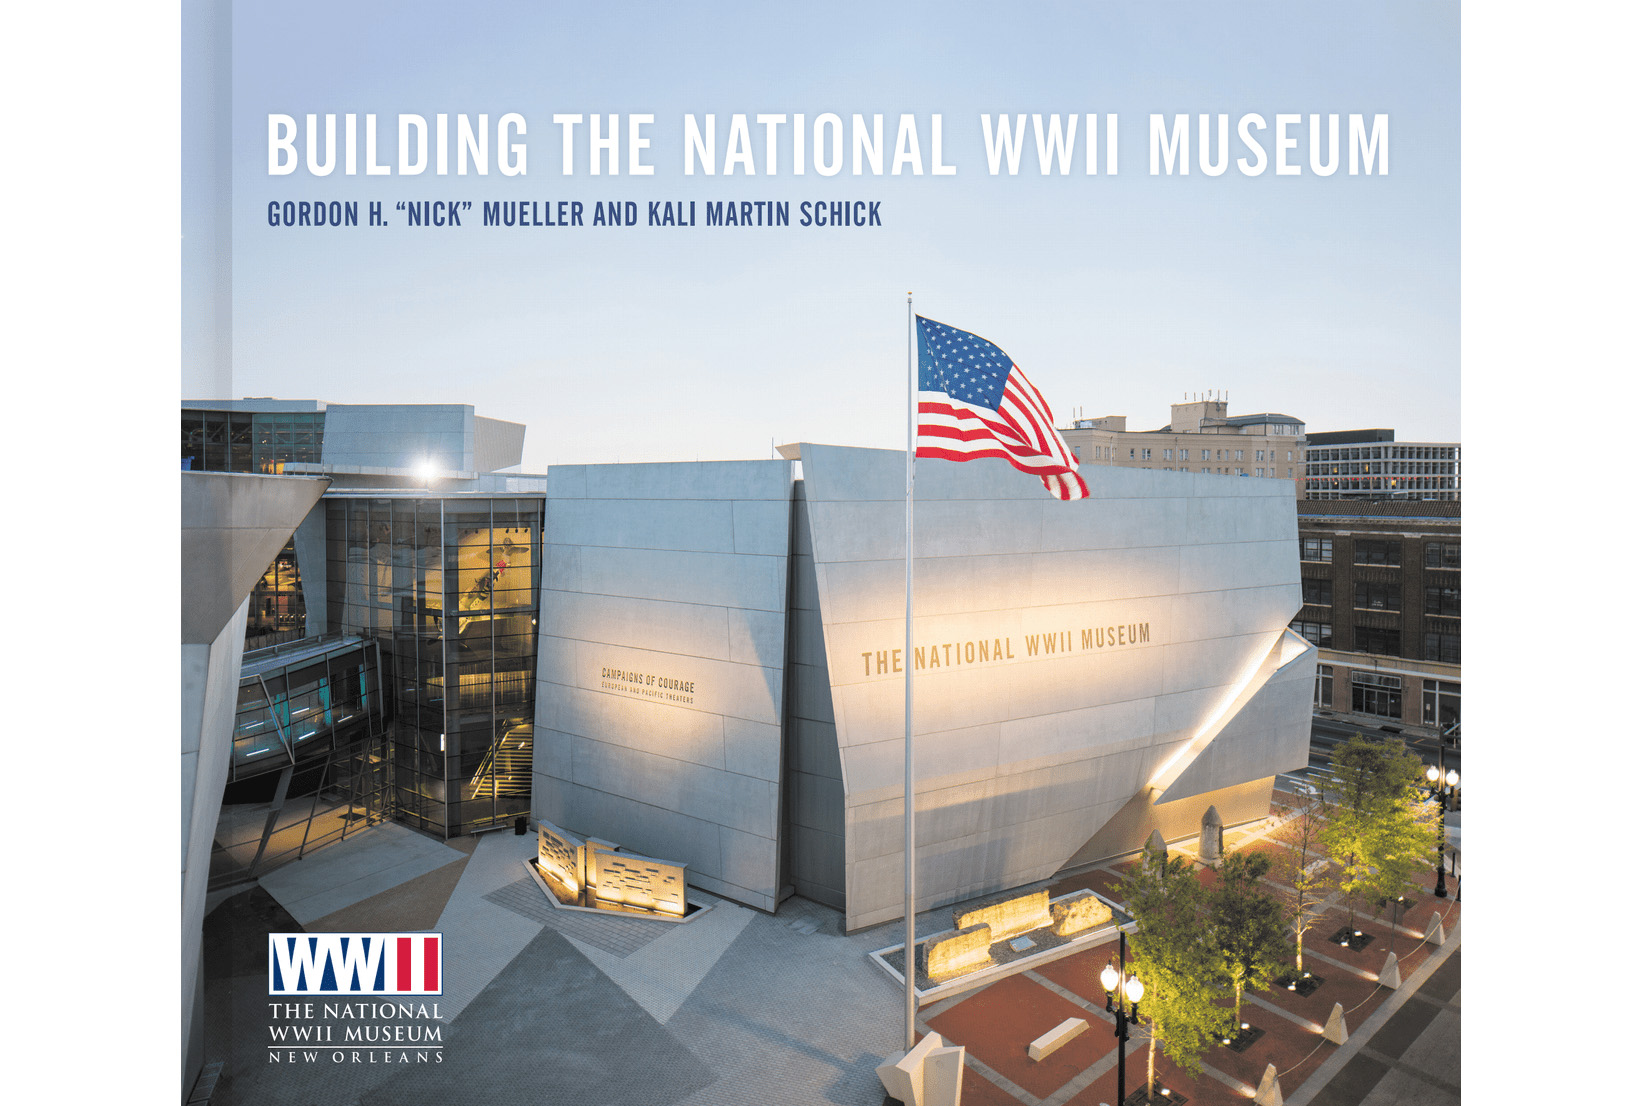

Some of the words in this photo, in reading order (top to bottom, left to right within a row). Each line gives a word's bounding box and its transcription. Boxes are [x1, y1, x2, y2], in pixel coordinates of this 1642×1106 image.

[861, 649, 903, 676] THE
[914, 637, 1015, 670] NATIONAL
[1025, 630, 1072, 657] WWII
[1081, 622, 1150, 650] MUSEUM
[601, 667, 643, 684] CAMPAIGNS
[645, 674, 656, 686] OF
[658, 677, 695, 693] COURAGE
[601, 681, 628, 692] EUROPEAN
[629, 686, 640, 695] AND
[641, 688, 663, 699] PACIFIC
[665, 692, 694, 704] THEATERS
